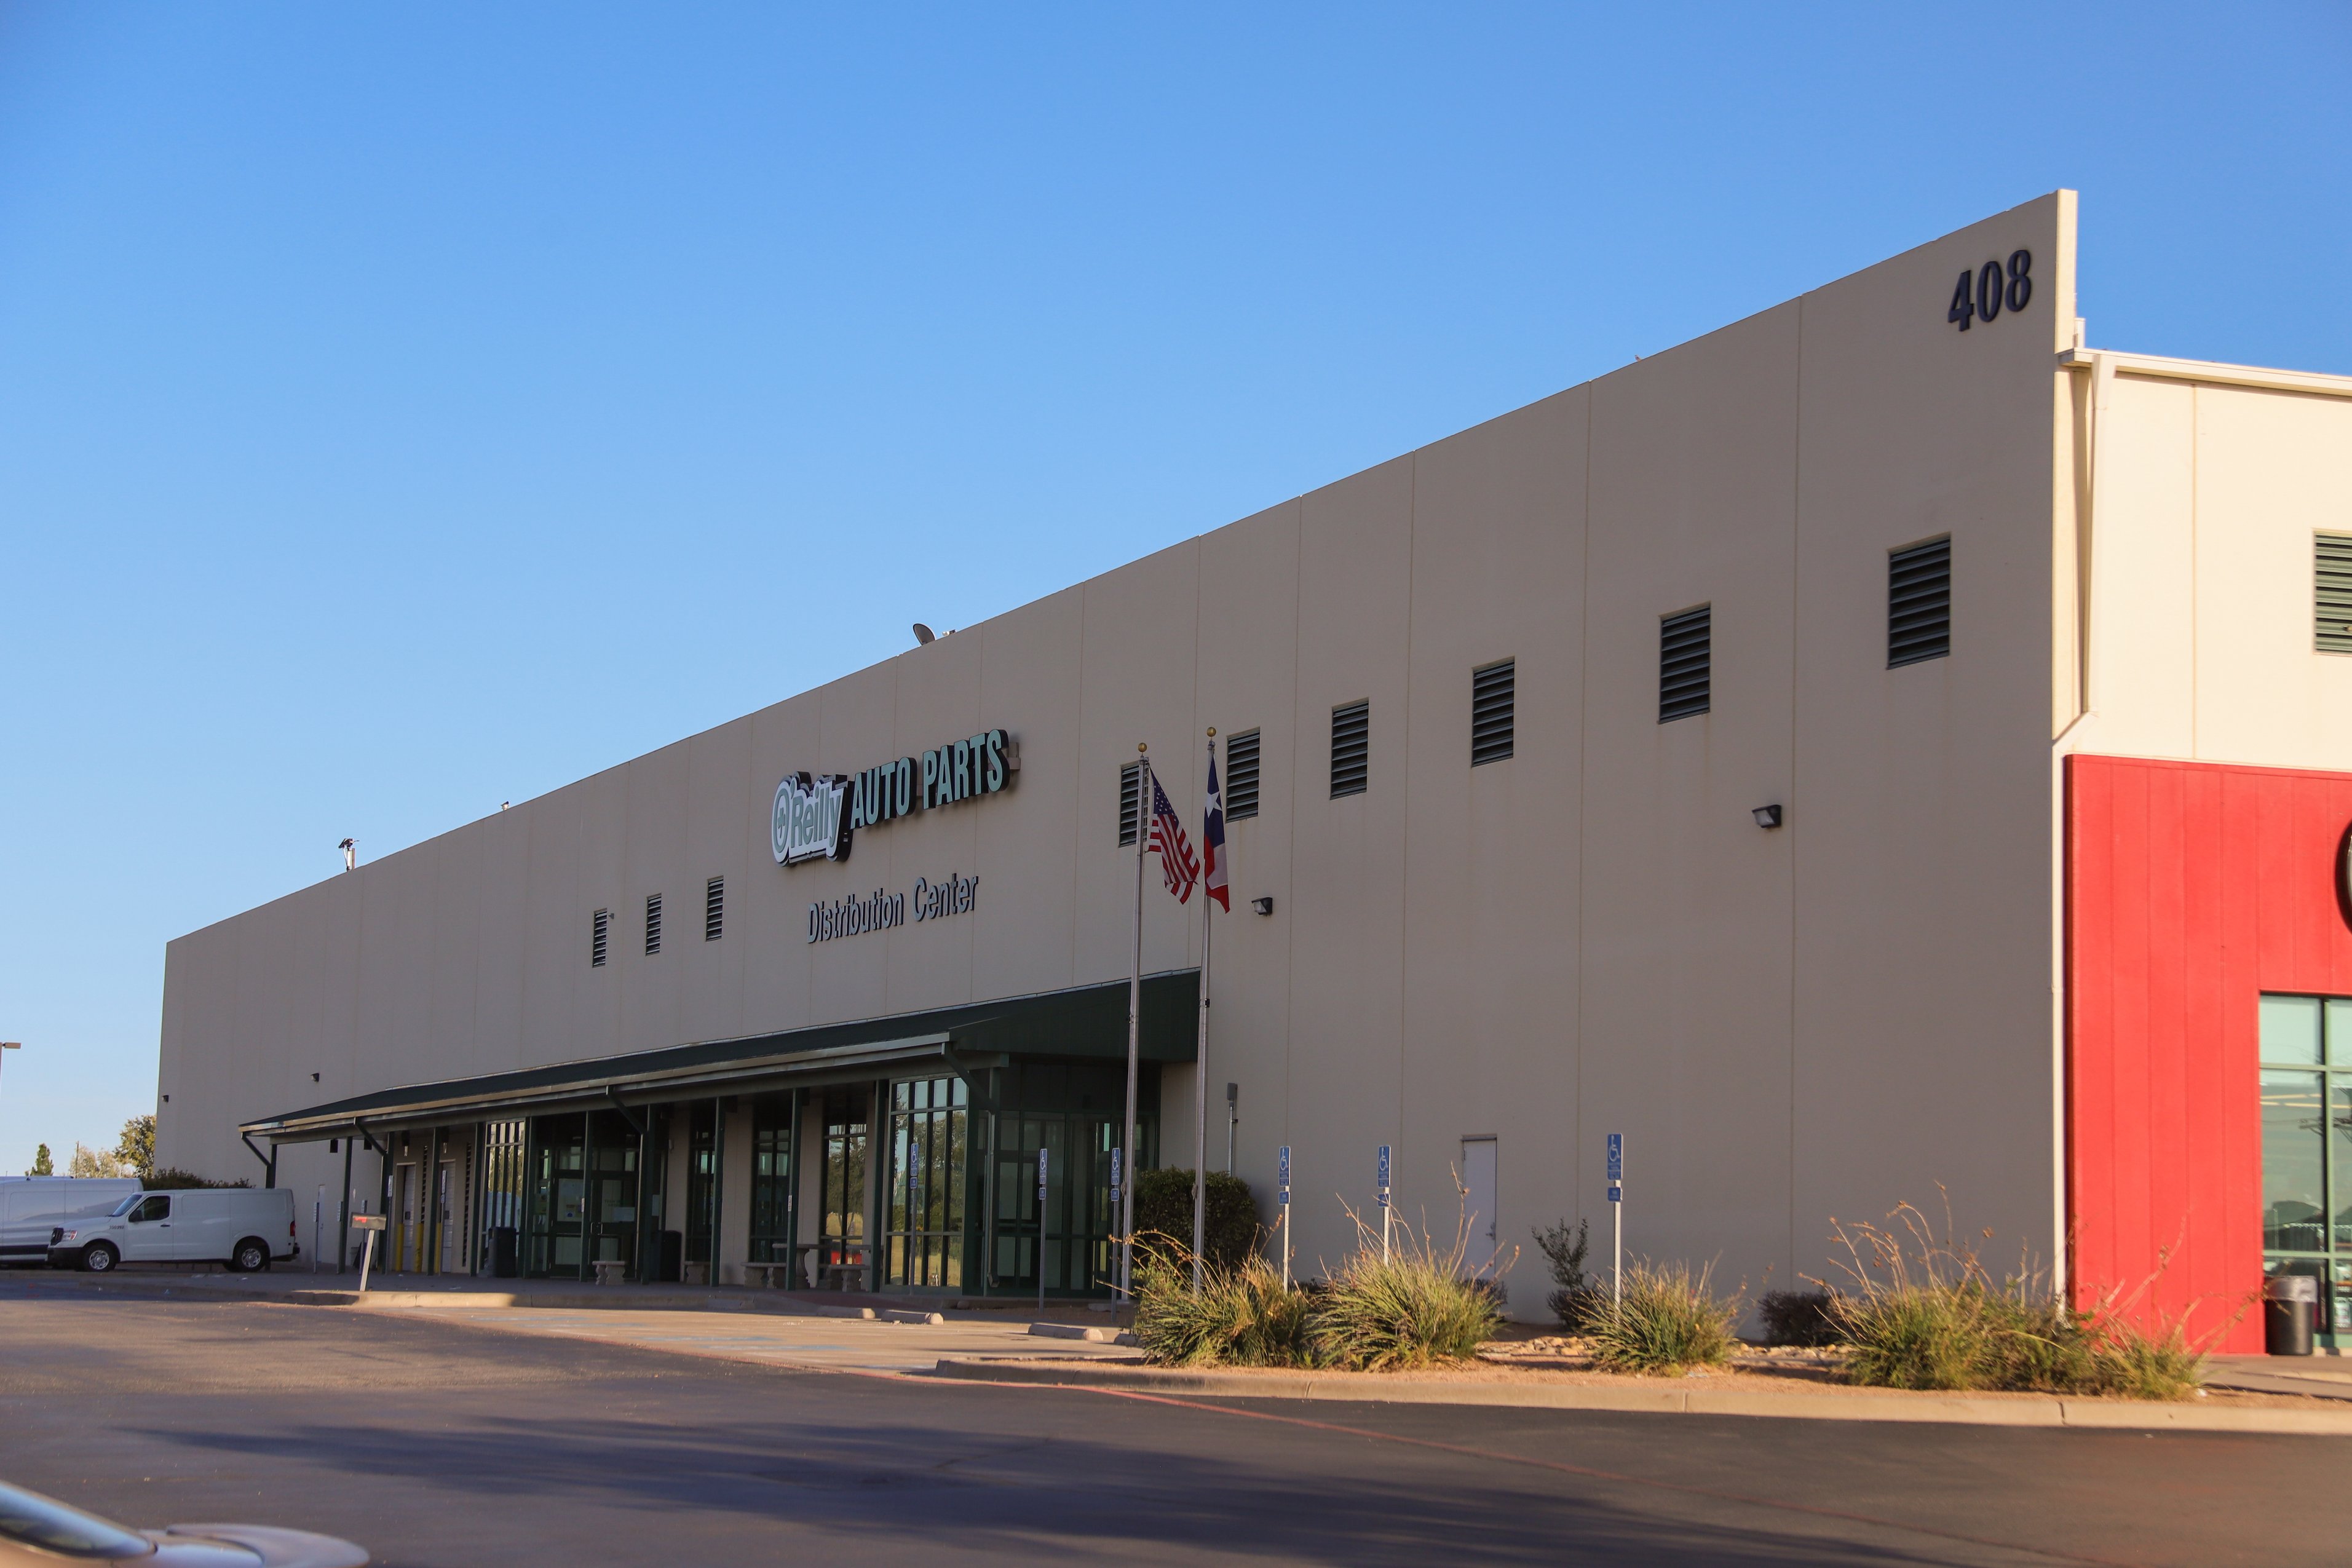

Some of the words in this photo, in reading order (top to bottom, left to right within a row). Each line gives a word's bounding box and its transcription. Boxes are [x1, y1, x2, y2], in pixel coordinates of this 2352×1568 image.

[1947, 249, 2032, 332] 408
[772, 774, 845, 863] O'Reilly
[850, 756, 916, 830] AUTO
[923, 729, 1010, 810] PARTS
[807, 887, 905, 944] Distribution
[913, 873, 979, 922] Center
